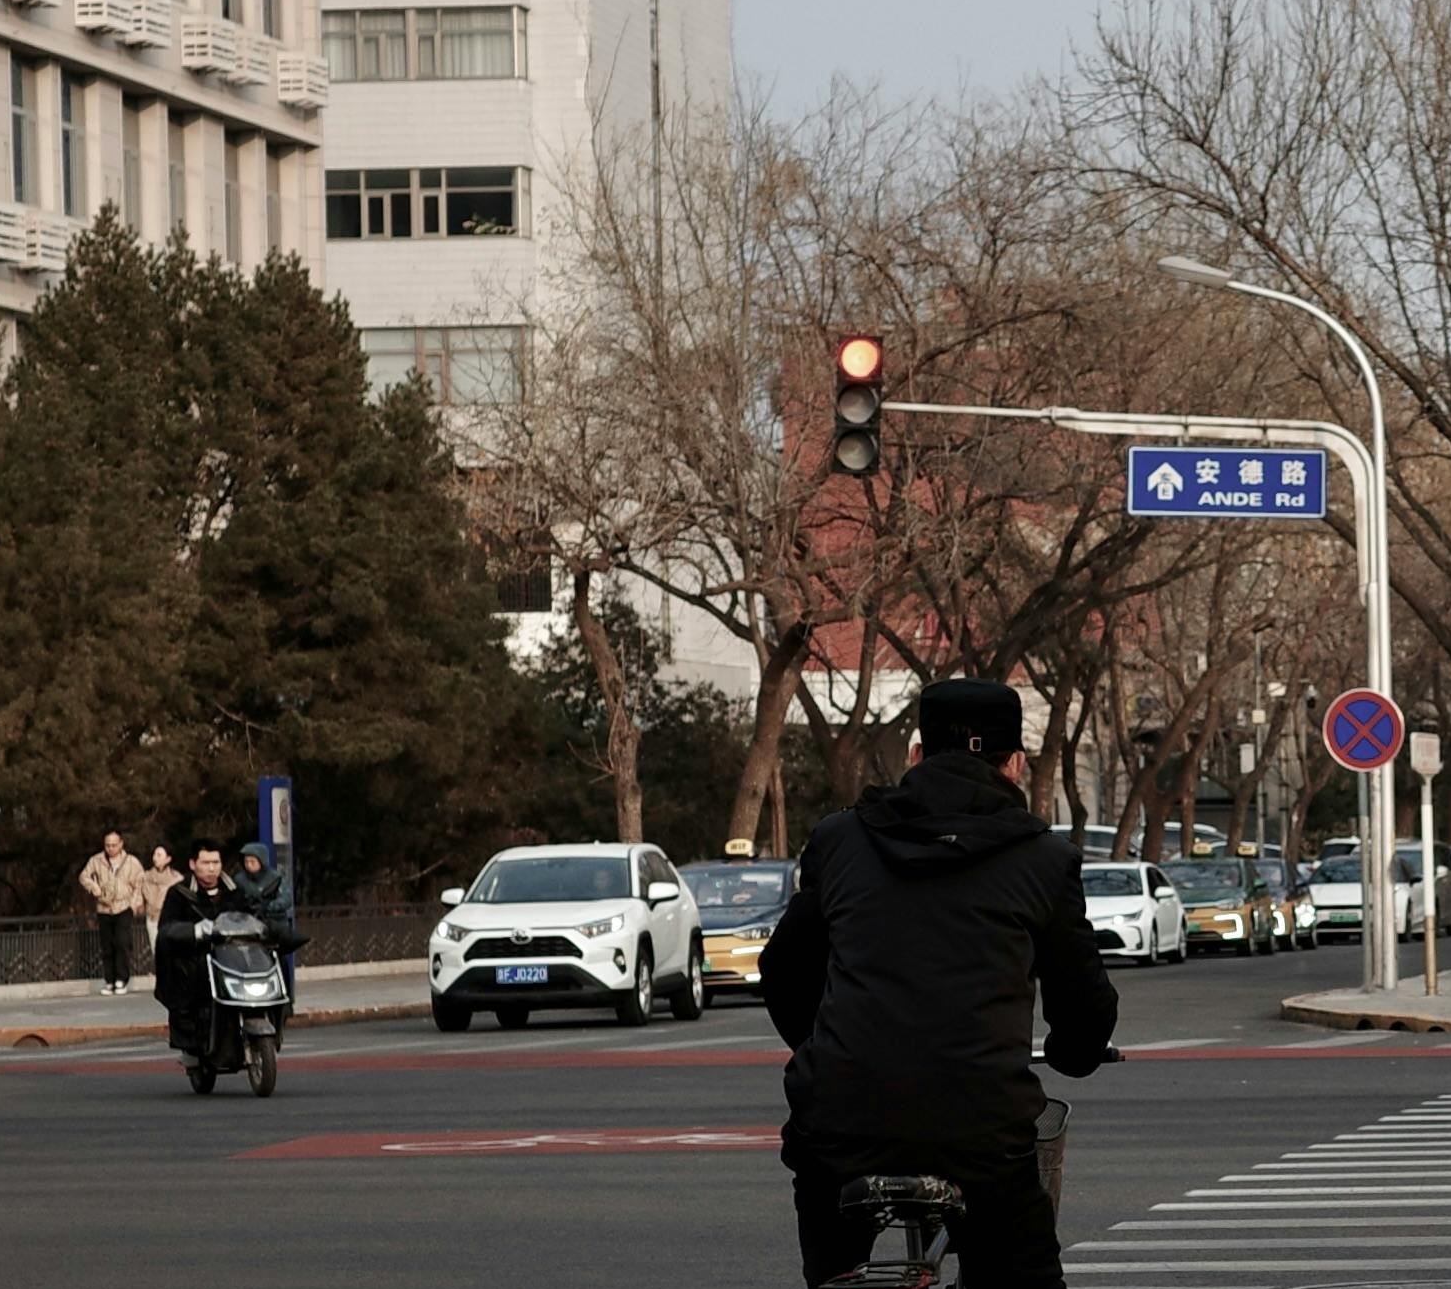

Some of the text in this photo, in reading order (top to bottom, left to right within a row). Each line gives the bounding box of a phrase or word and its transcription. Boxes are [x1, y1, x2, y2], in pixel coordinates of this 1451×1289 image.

[1195, 458, 1307, 486] 安德路
[1198, 491, 1306, 507] ANDE Rd
